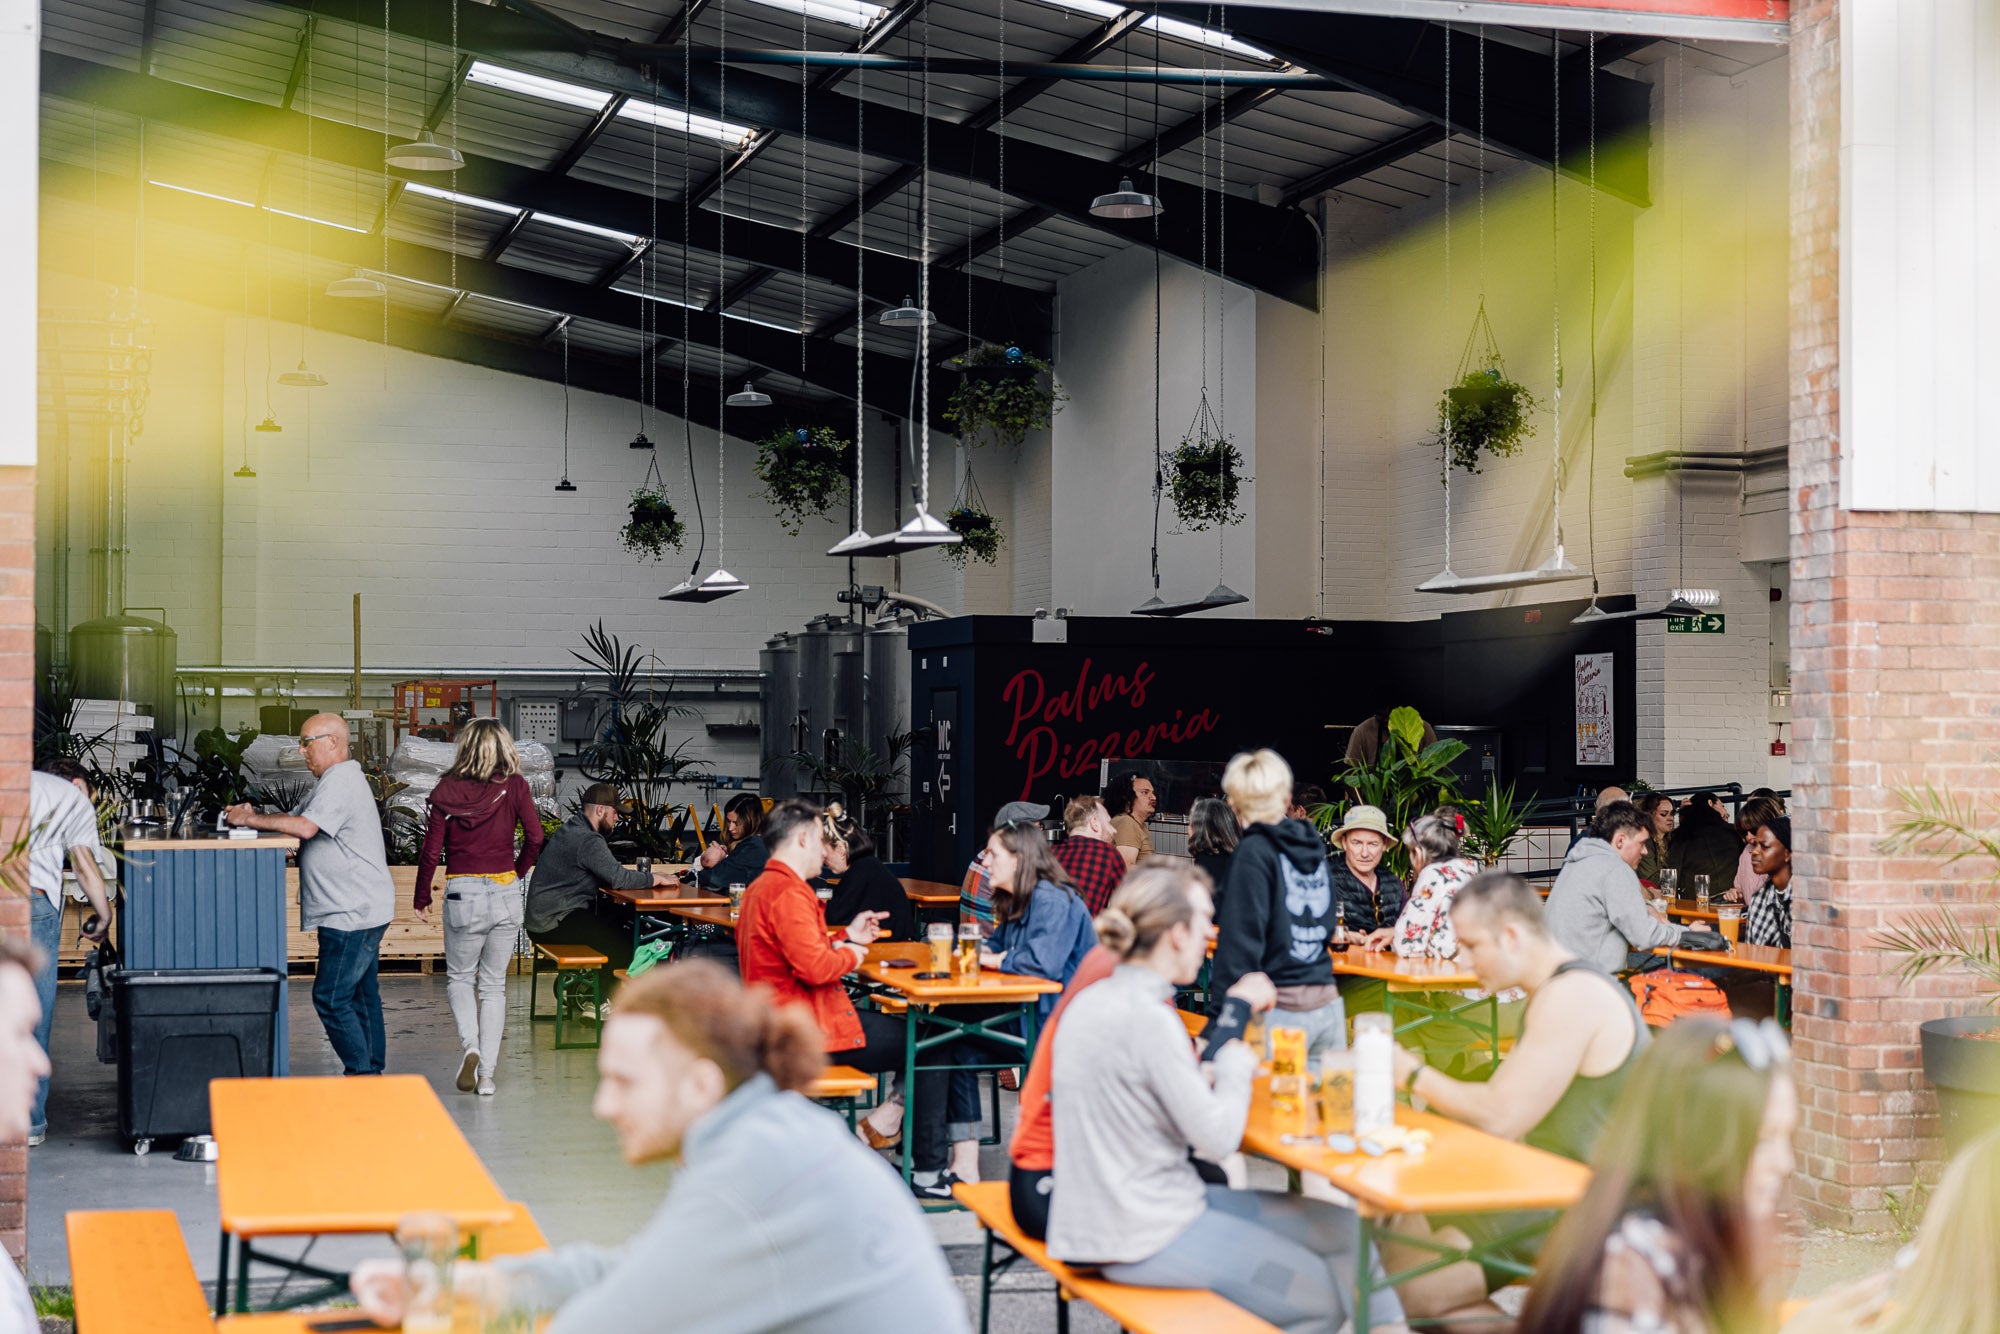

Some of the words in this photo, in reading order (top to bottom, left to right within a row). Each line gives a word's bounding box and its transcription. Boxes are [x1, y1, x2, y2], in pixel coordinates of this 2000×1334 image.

[938, 720, 951, 751] WC
[1003, 658, 1155, 745] Palms
[1016, 709, 1220, 800] Pizzeria
